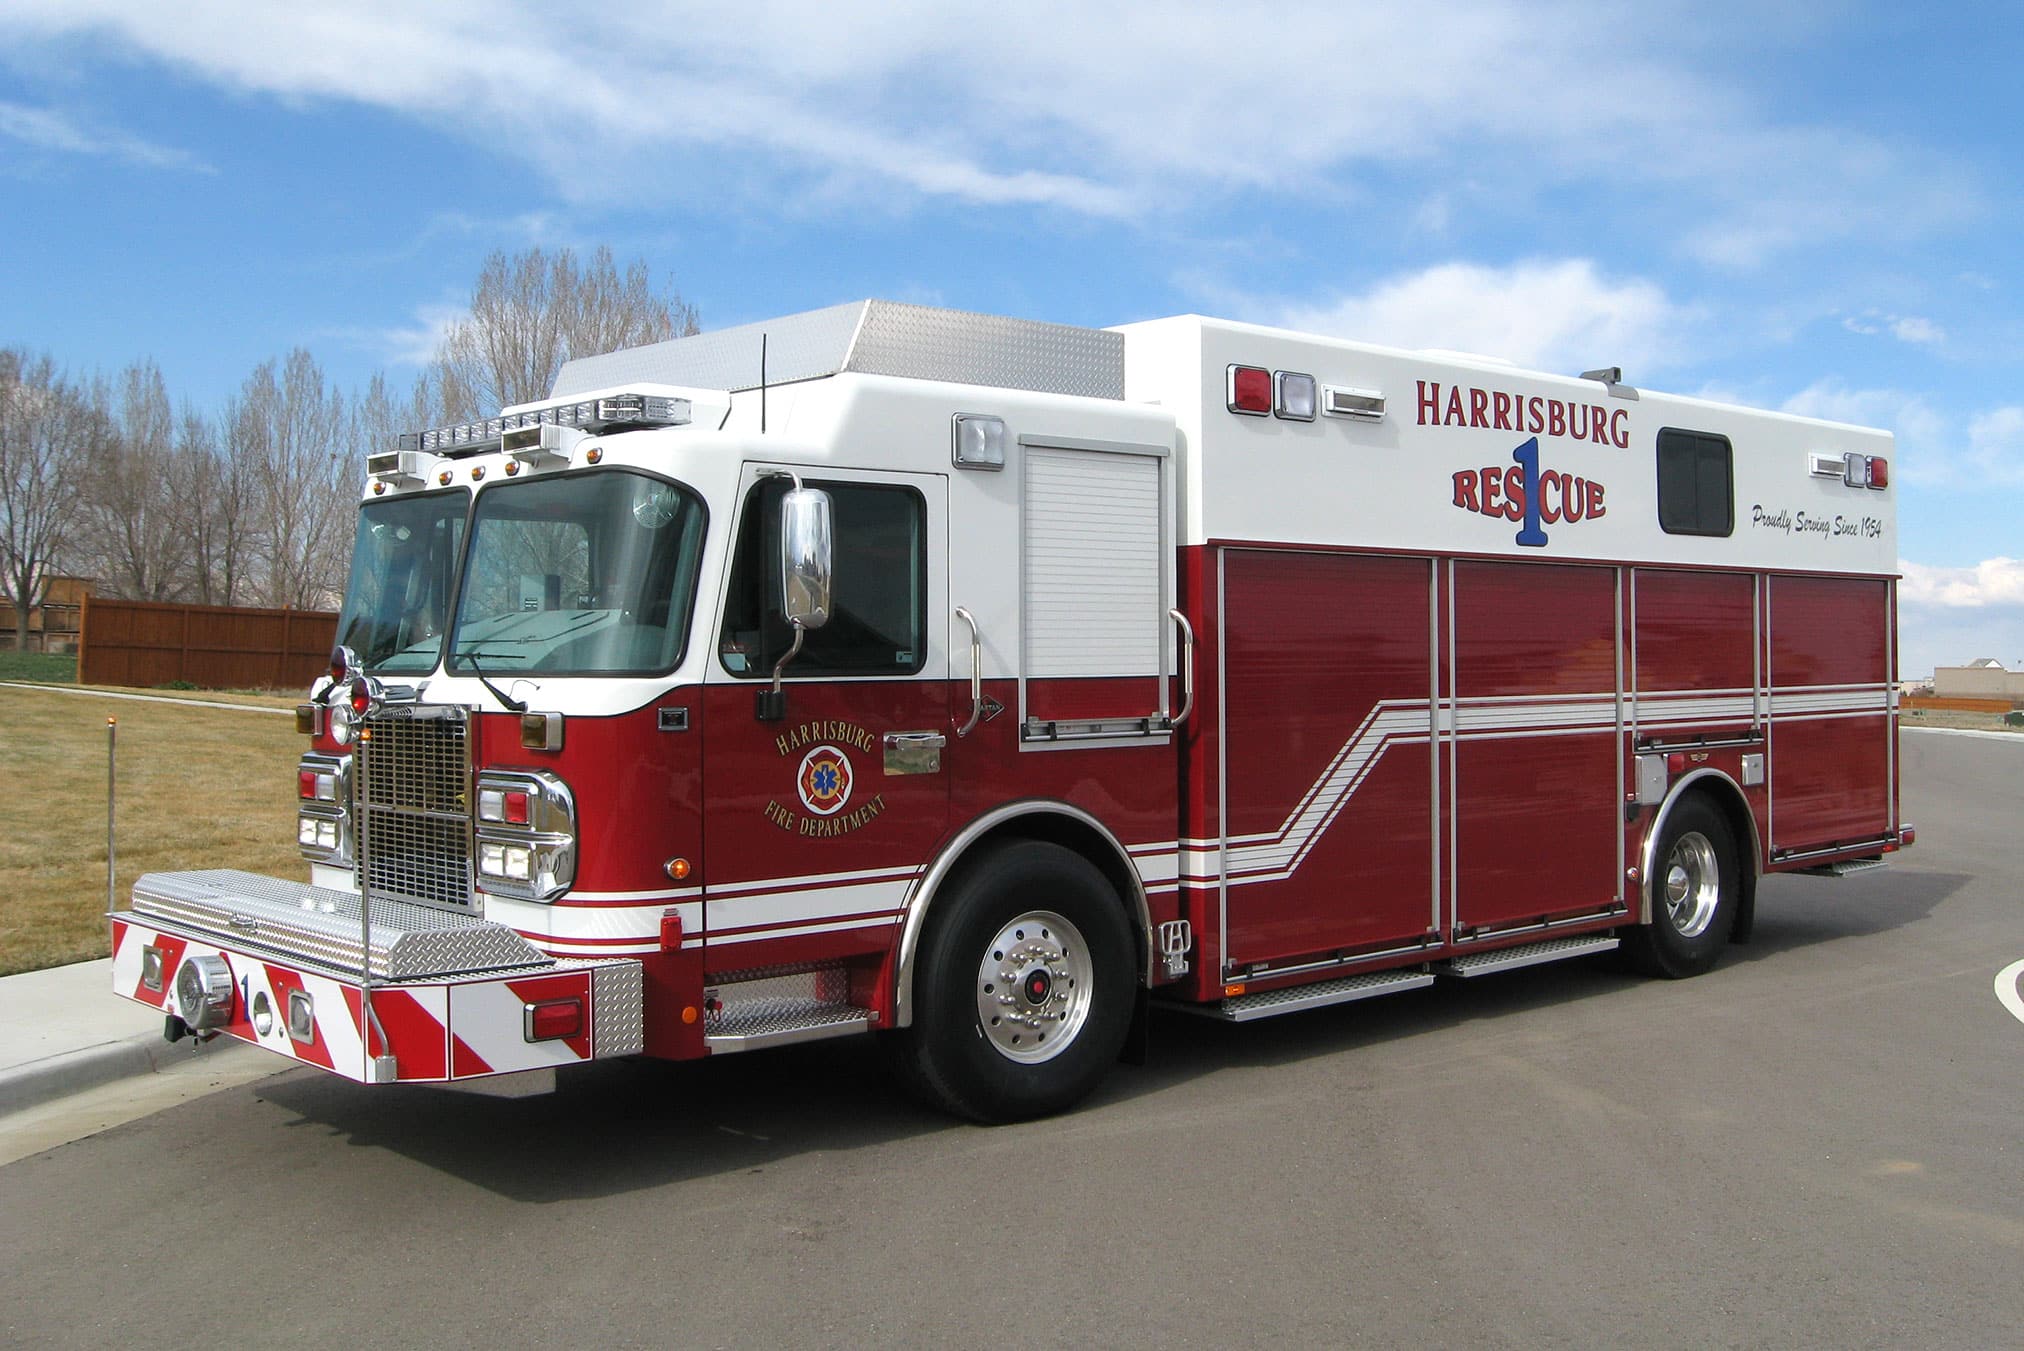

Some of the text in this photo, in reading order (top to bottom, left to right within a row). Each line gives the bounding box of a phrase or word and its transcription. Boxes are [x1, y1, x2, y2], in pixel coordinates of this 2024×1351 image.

[1416, 380, 1629, 449] HARRISBURG
[1452, 465, 1606, 525] RESCUE
[1512, 436, 1548, 547] 1
[1752, 504, 1882, 540] Proudly Serving Since 1954
[776, 720, 875, 757] HARRISBURG
[764, 793, 886, 838] FIRE DEPARTMENT
